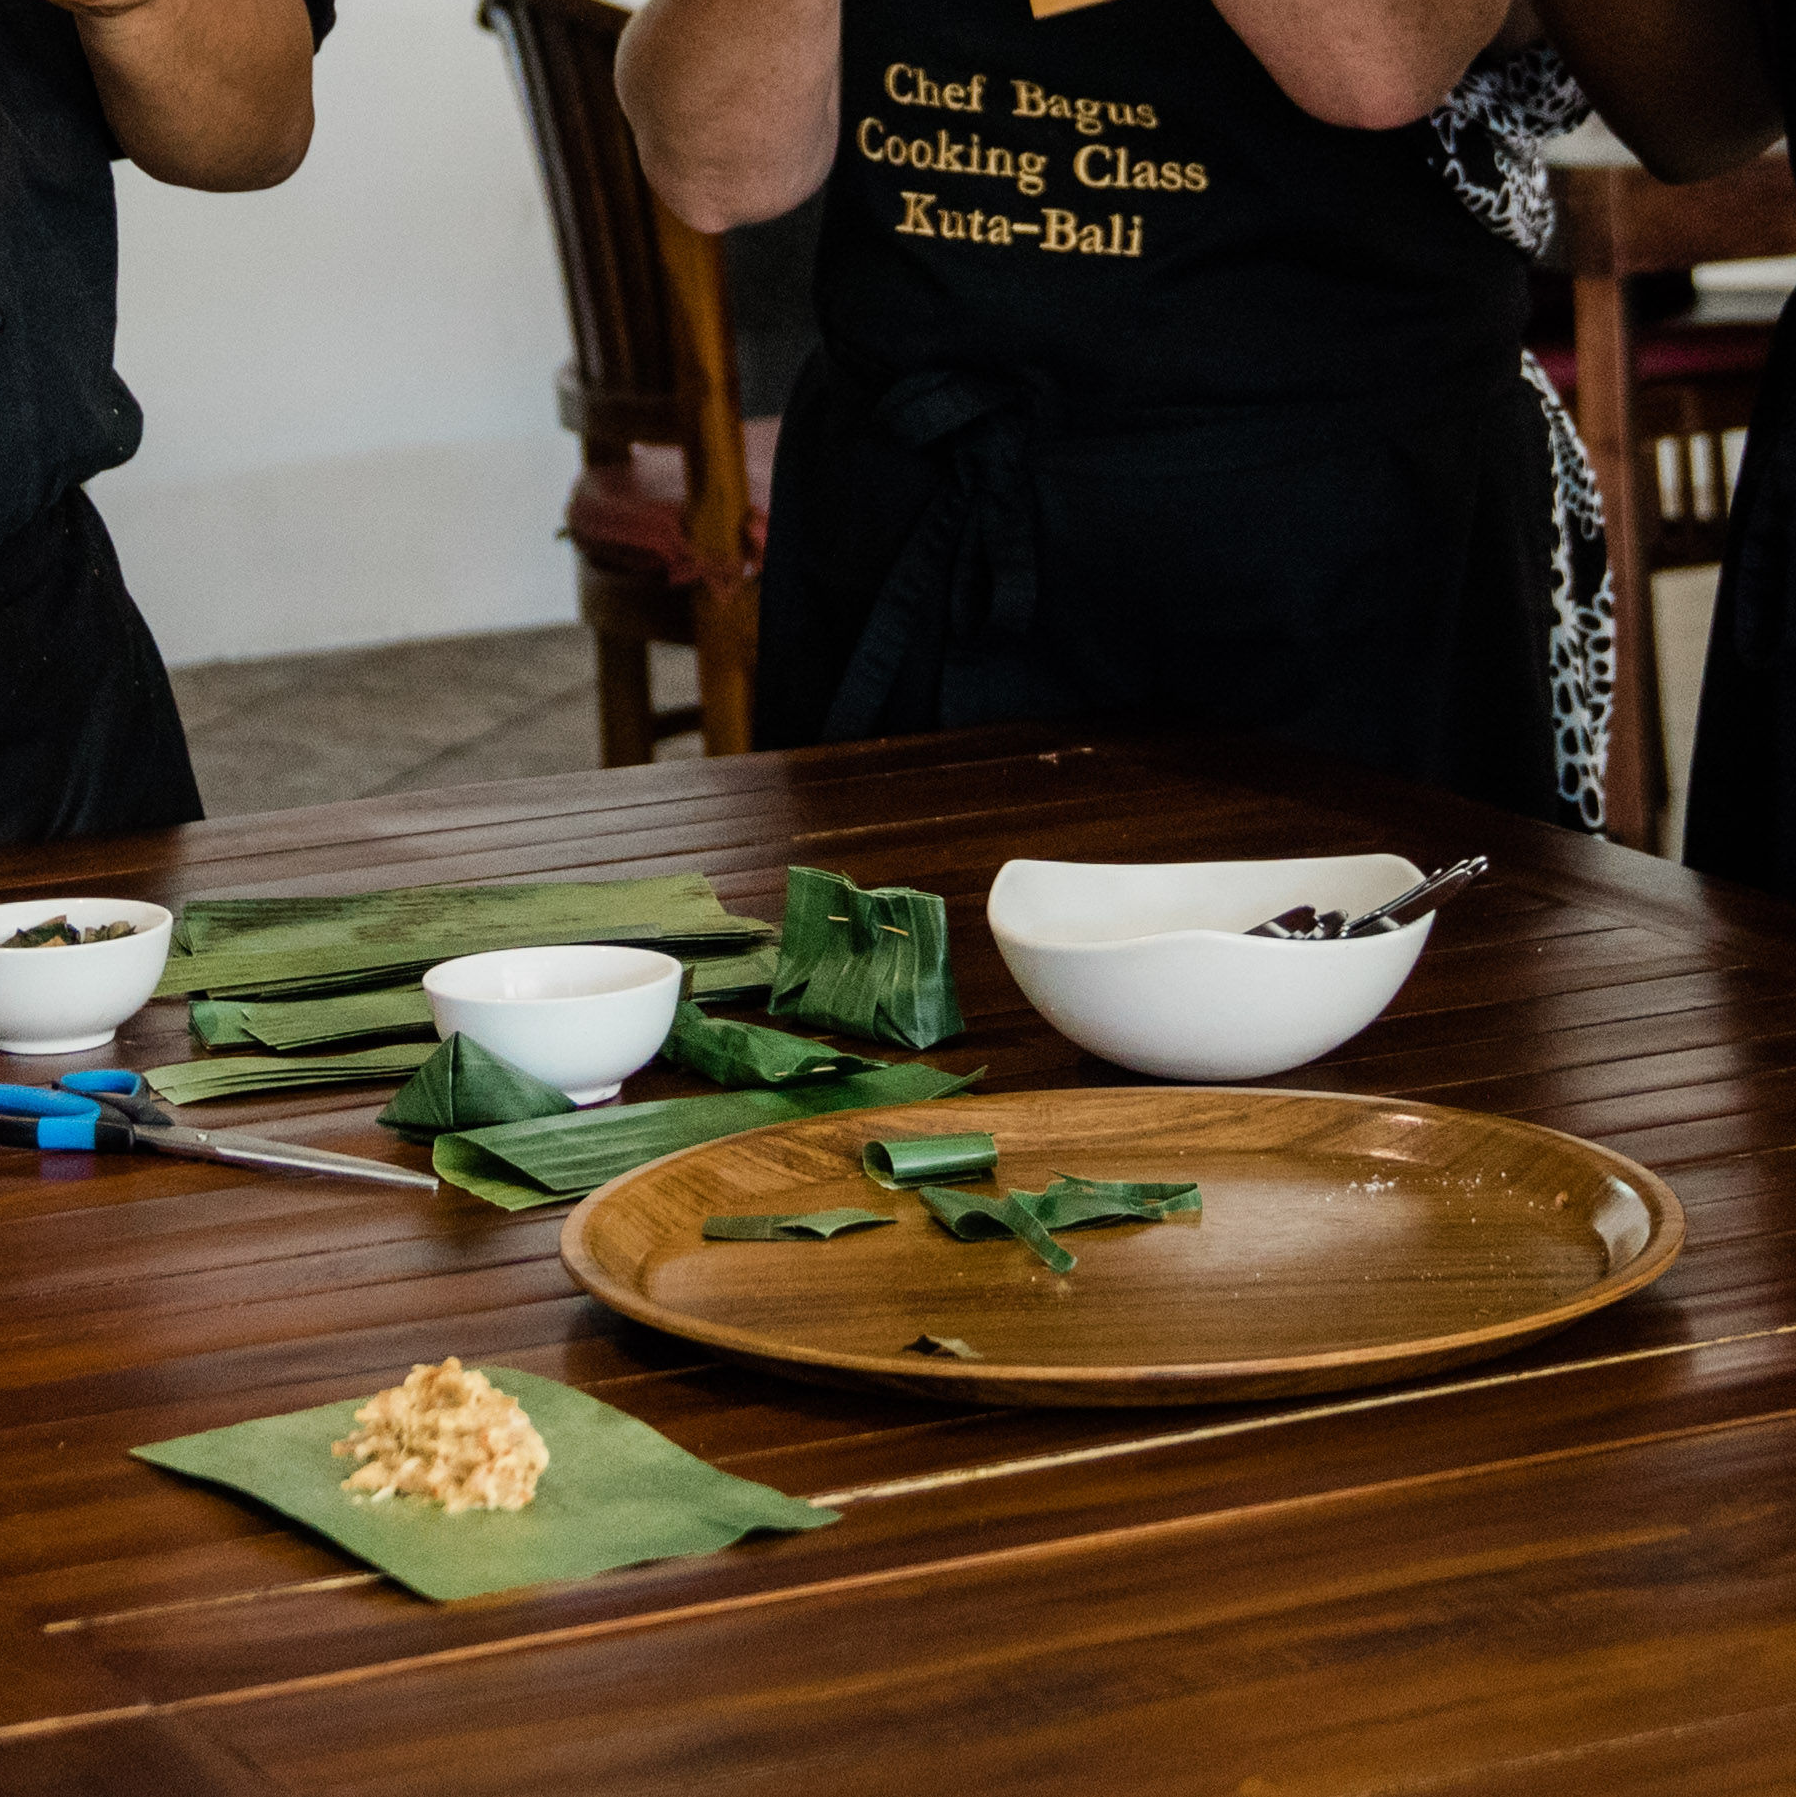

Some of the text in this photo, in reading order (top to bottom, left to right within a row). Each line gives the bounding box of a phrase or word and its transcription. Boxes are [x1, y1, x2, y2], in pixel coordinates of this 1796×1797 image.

[883, 62, 1160, 136] Chef Bagus
[856, 116, 1210, 197] Cooking Class
[894, 190, 1145, 258] Kuta-Bali
